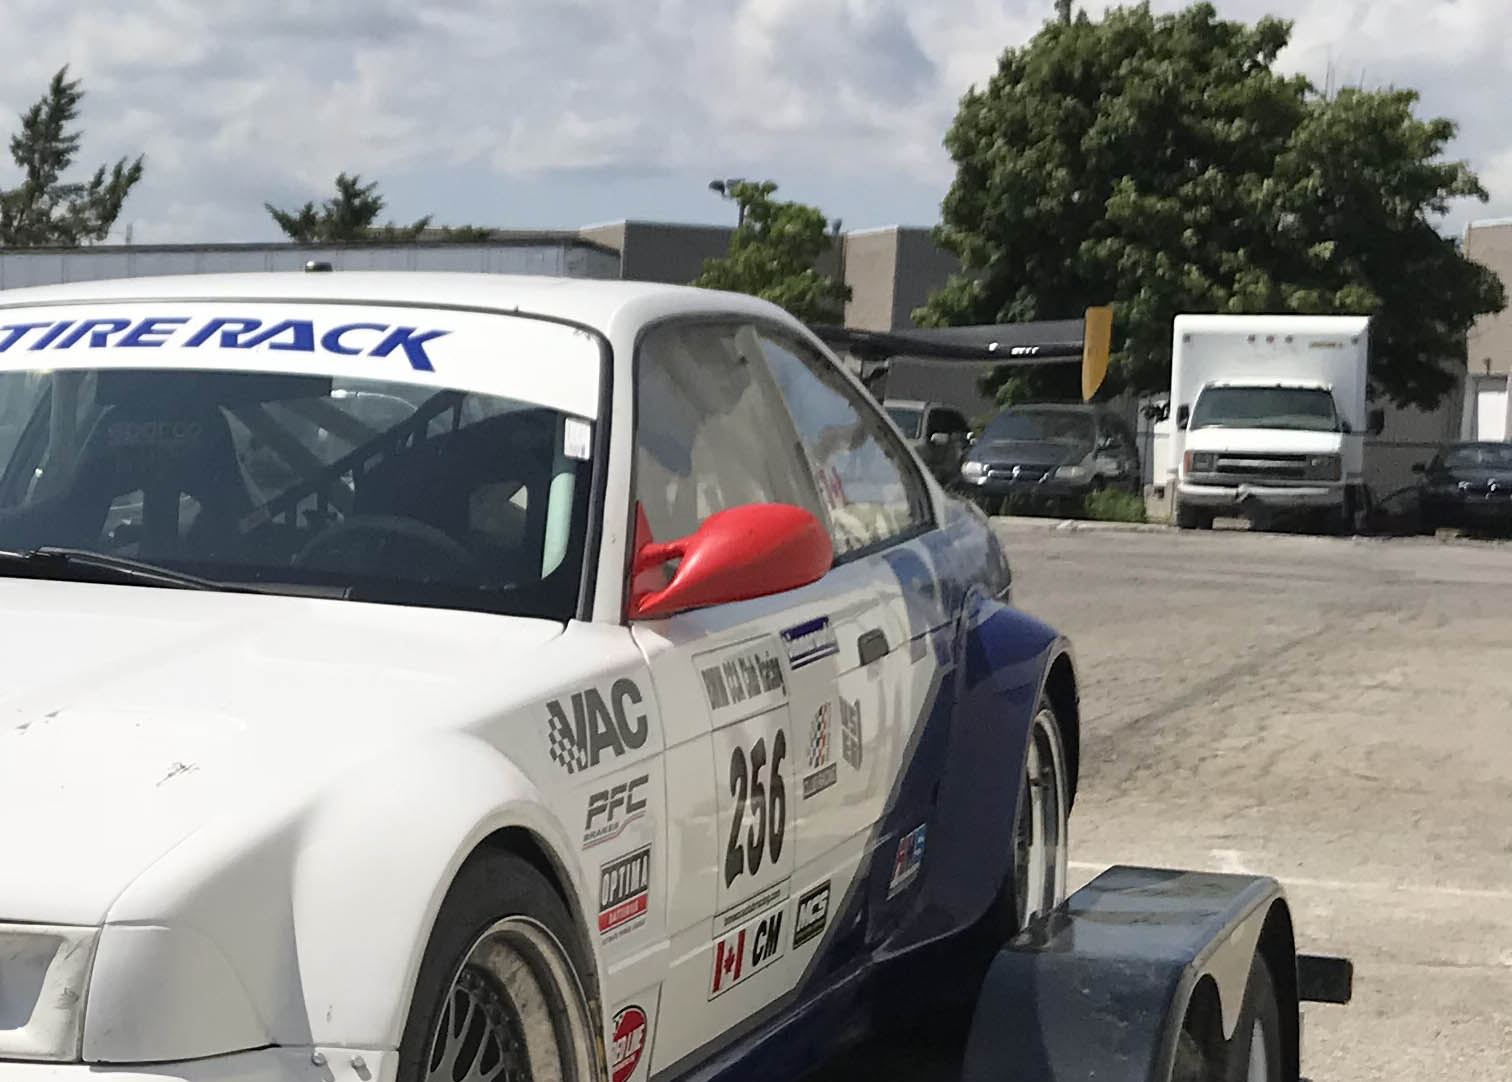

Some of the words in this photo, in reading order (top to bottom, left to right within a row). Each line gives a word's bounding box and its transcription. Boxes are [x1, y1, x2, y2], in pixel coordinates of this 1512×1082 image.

[182, 316, 455, 372] RACK
[546, 678, 648, 774] VAC
[585, 774, 649, 830] PFC
[725, 728, 787, 889] 256
[601, 855, 648, 906] OPTIMA
[752, 909, 784, 967] CM
[796, 888, 829, 934] MCS
